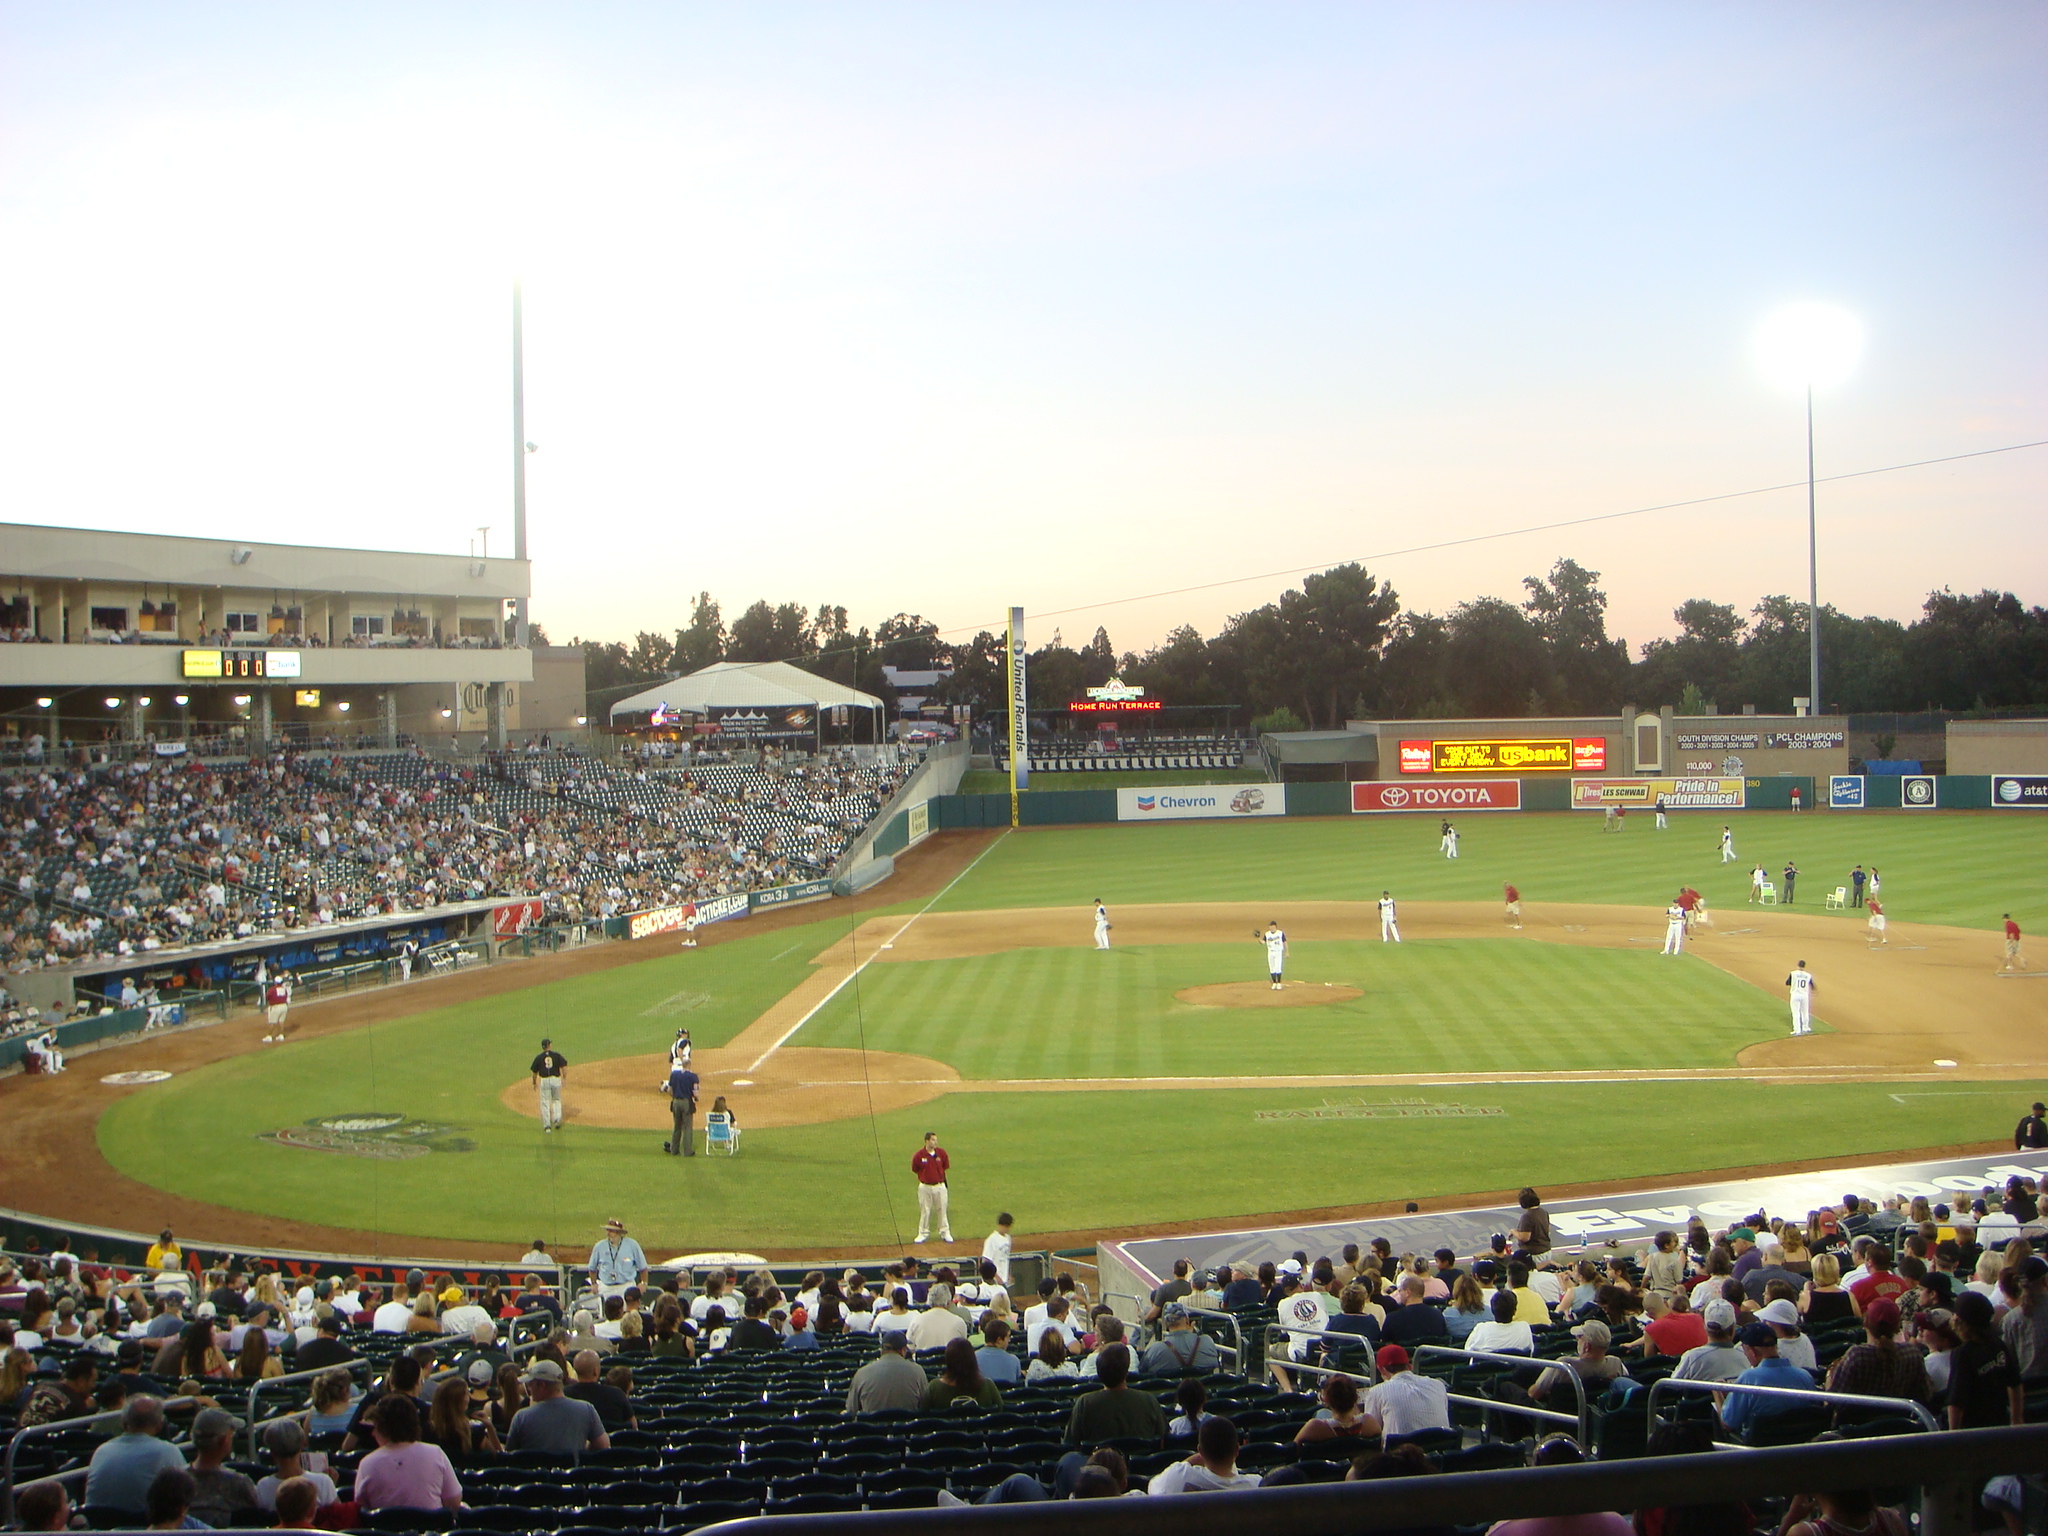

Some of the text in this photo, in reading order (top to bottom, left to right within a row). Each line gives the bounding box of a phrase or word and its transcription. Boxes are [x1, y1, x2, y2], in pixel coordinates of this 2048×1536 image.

[225, 659, 233, 676] 0
[241, 659, 248, 676] 0
[255, 659, 263, 676] 0
[1013, 658, 1026, 752] United Rentals
[1070, 701, 1160, 711] HOME RUN TERRACE
[1701, 734, 1730, 742] DIVISION
[1730, 734, 1759, 742] CHAMPS
[1776, 732, 1843, 741] PCL CHAMPIONS
[1788, 741, 1807, 749] 2003
[1686, 761, 1712, 771] $10,000
[1584, 786, 1646, 798] Tires LES SCHWAB
[1675, 779, 1719, 793] Pride In
[2024, 785, 2048, 796] at&t
[1160, 796, 1216, 808] Chevron
[1412, 788, 1491, 804] TOYOTA
[1656, 790, 1738, 805] Performance!
[775, 889, 782, 901] 3
[1797, 979, 1806, 988] 10
[544, 1056, 554, 1069] 9
